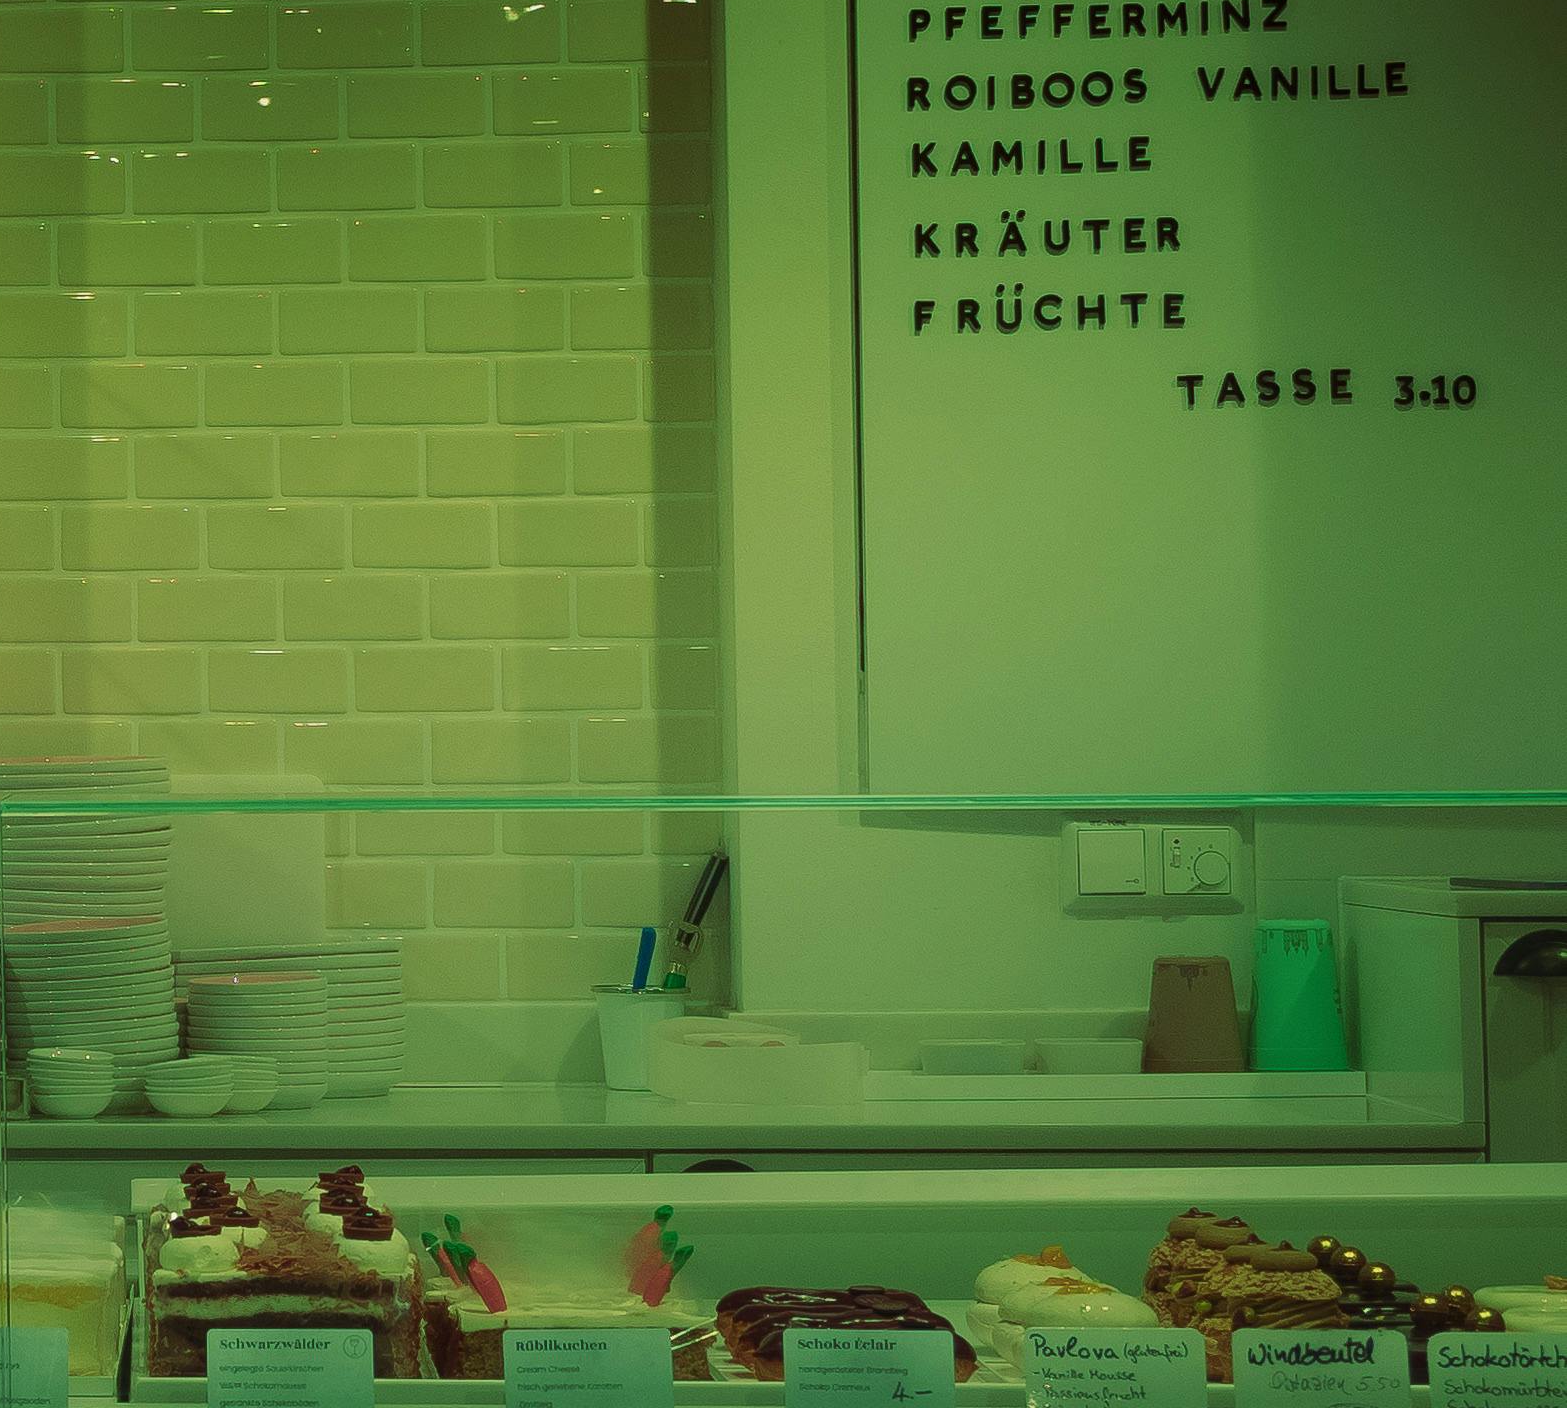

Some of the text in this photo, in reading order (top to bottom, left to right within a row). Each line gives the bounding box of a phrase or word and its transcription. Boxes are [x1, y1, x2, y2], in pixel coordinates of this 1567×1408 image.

[906, 62, 1409, 111] ROIBOOS VANILLE
[911, 136, 1153, 178] KAMILLE
[914, 210, 1181, 259] KRÄUTER
[914, 283, 1186, 335] FRÜCHTE
[1177, 368, 1478, 410] TASSE 3.10
[219, 1337, 331, 1350] Schwarzwälder
[516, 1339, 608, 1352] Rüblikuchen
[797, 1338, 851, 1350] Schoko
[1029, 1333, 1119, 1360] Pavlova
[1247, 1336, 1375, 1366] Windbeutel
